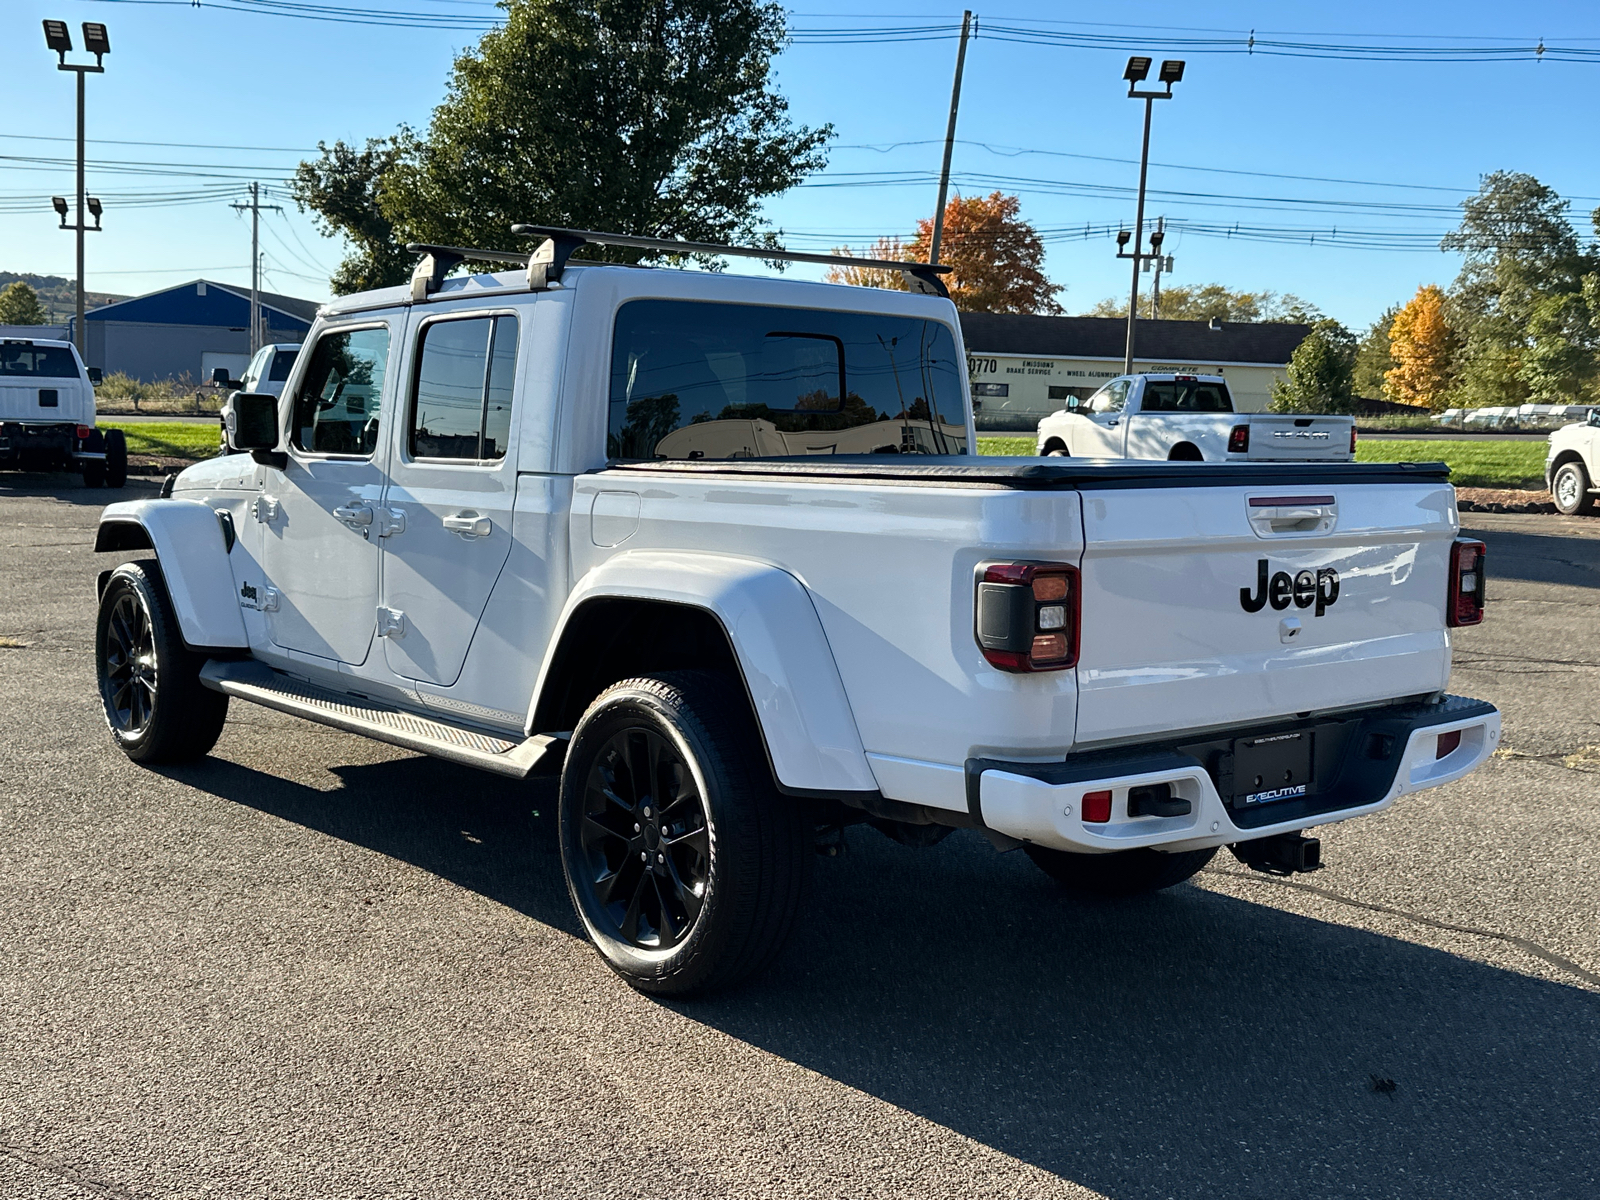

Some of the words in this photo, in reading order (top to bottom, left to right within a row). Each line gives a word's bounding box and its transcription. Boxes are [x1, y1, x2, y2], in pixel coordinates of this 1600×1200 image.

[1022, 360, 1055, 368] EMISSIONS
[1006, 367, 1025, 375] BRAKE
[1087, 370, 1121, 378] ALIGNMENT
[1239, 559, 1340, 617] Jeep
[1246, 785, 1306, 803] EXECUTIVE
